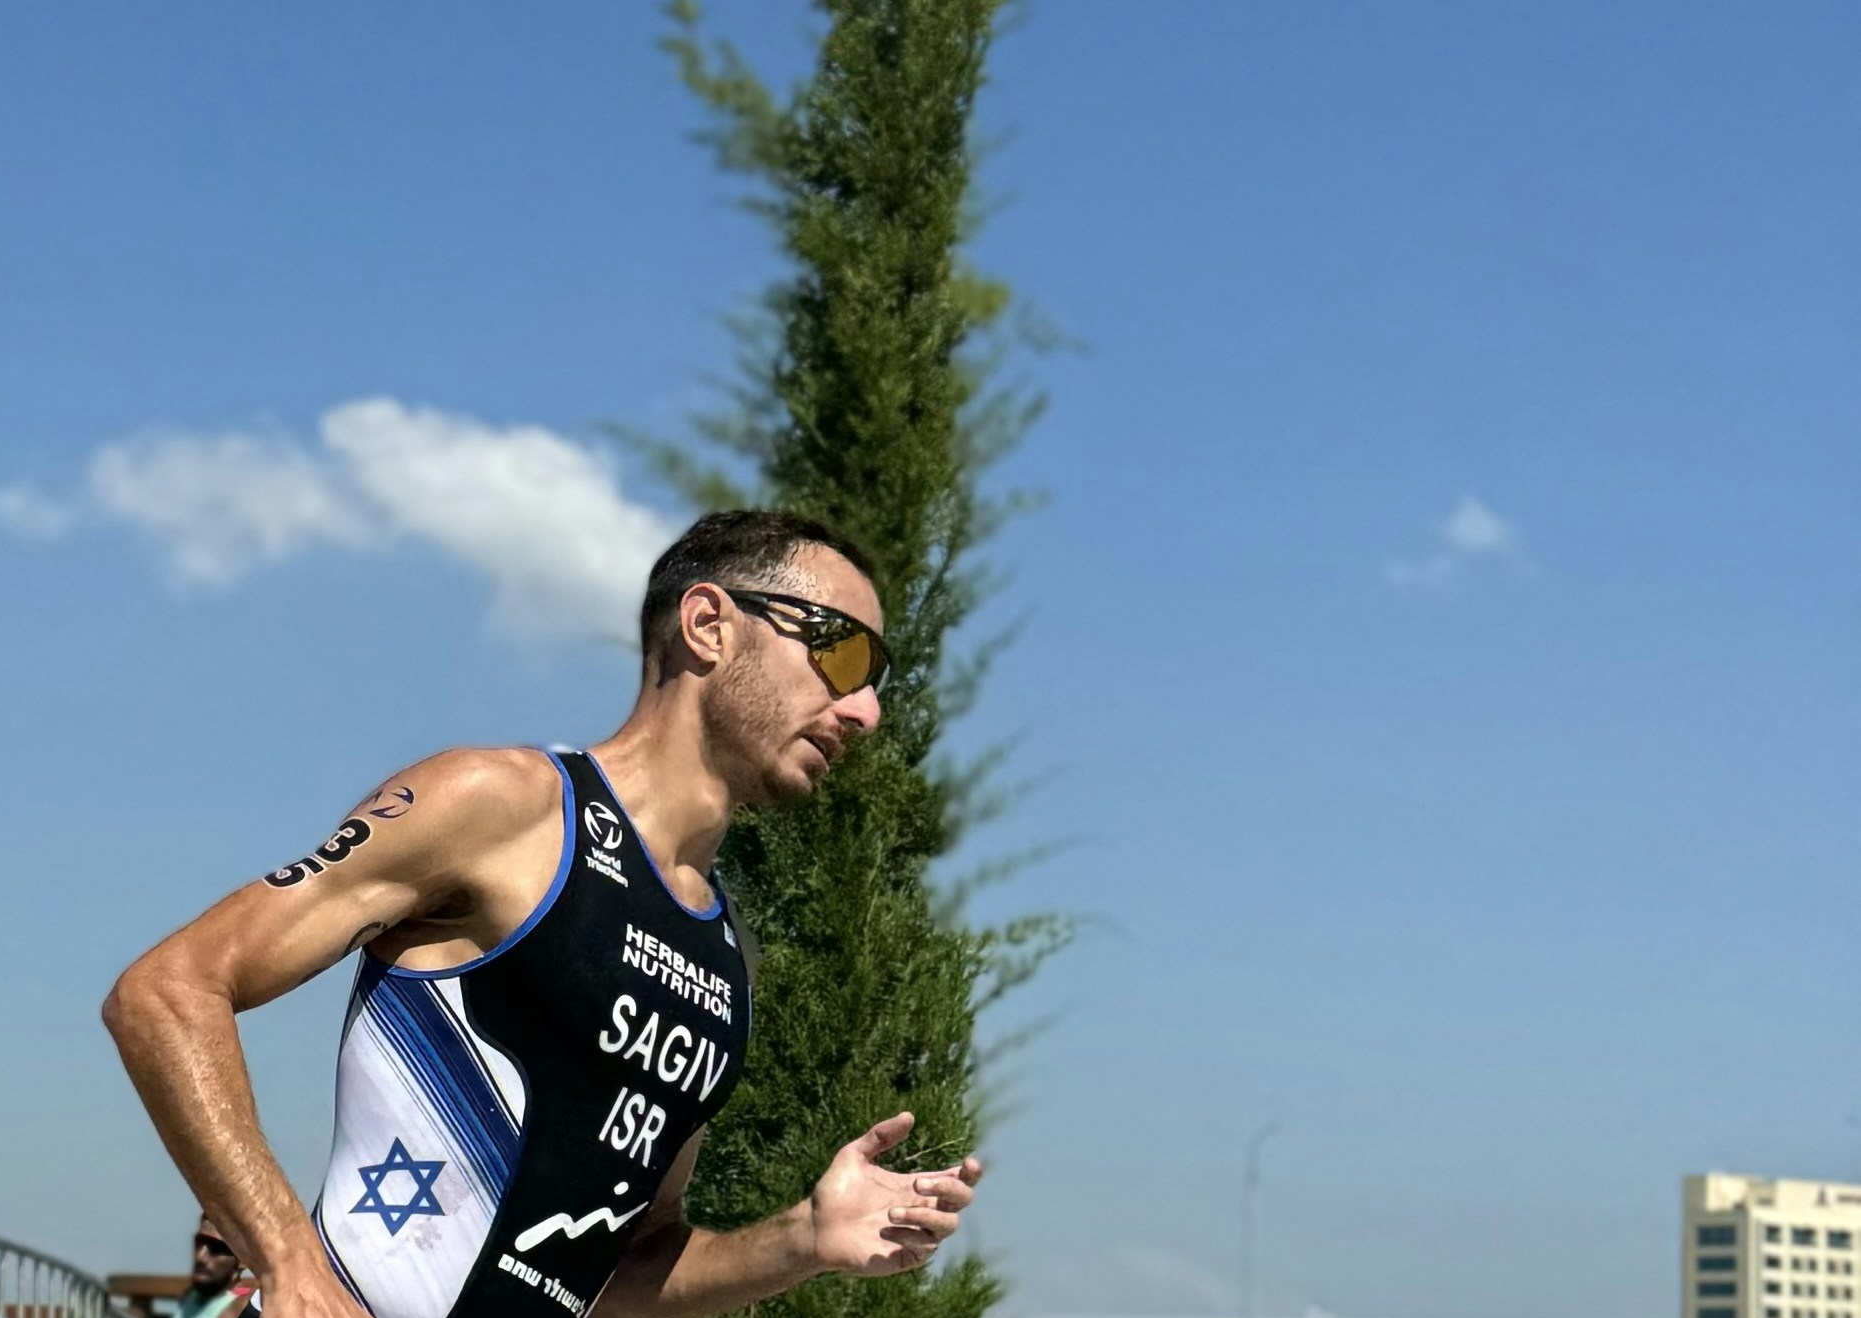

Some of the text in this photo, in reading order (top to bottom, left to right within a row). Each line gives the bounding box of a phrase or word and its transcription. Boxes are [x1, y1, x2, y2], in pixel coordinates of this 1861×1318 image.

[622, 945, 732, 1025] NUTRITION
[625, 923, 732, 1004] HERBALIFE
[598, 994, 729, 1102] SAGIV
[598, 1086, 667, 1168] ISR
